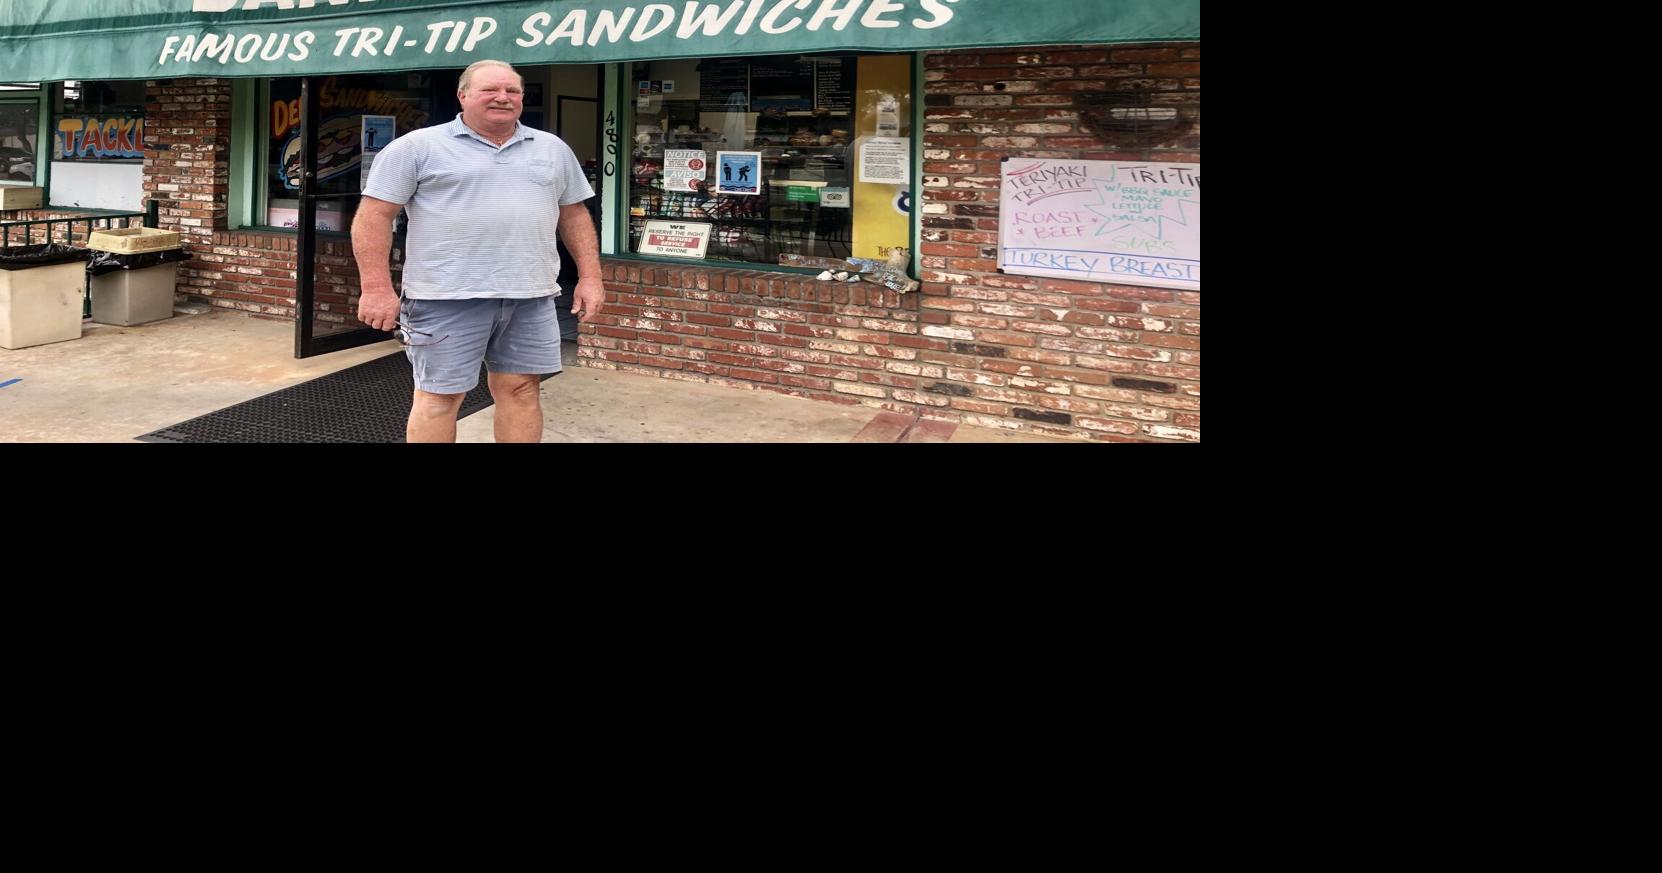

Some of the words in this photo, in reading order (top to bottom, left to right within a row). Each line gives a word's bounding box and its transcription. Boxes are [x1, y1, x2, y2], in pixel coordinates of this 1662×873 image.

[159, 30, 315, 65] FAMOUS
[333, 16, 498, 58] TRI-TIP
[515, 0, 961, 47] SANDWICHES
[670, 170, 700, 178] AVISO
[1007, 165, 1088, 191] TERIYAKI
[1011, 178, 1087, 202] TRI-TIP
[1013, 211, 1089, 225] ROAST
[1034, 225, 1090, 239] BEEF
[1007, 250, 1099, 278] TURKEY
[1110, 256, 1198, 278] BREAST
